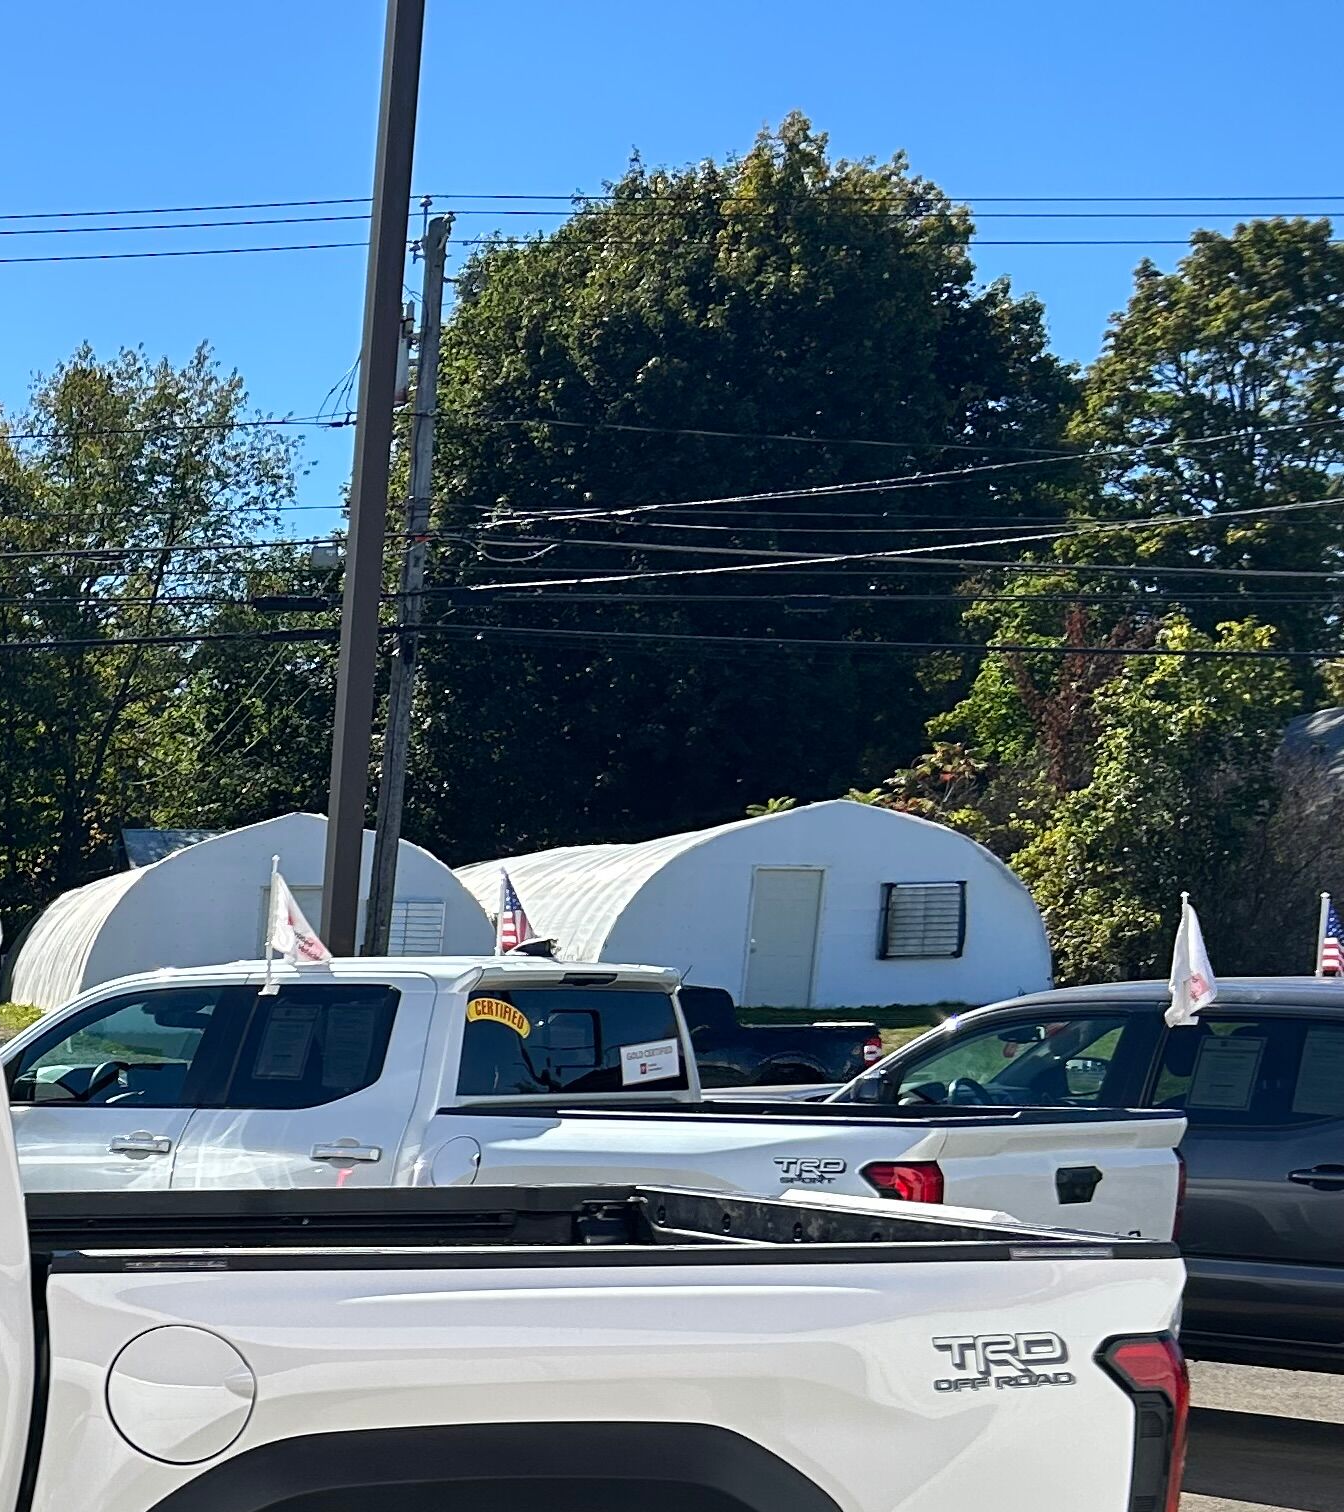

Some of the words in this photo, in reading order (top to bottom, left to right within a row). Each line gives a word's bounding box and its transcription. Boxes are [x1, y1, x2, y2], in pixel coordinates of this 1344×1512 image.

[475, 1000, 524, 1029] CERTIFIED
[773, 1157, 847, 1177] TRD
[931, 1331, 1069, 1376] TRD
[933, 1376, 990, 1393] OFF
[994, 1372, 1077, 1390] ROAD
